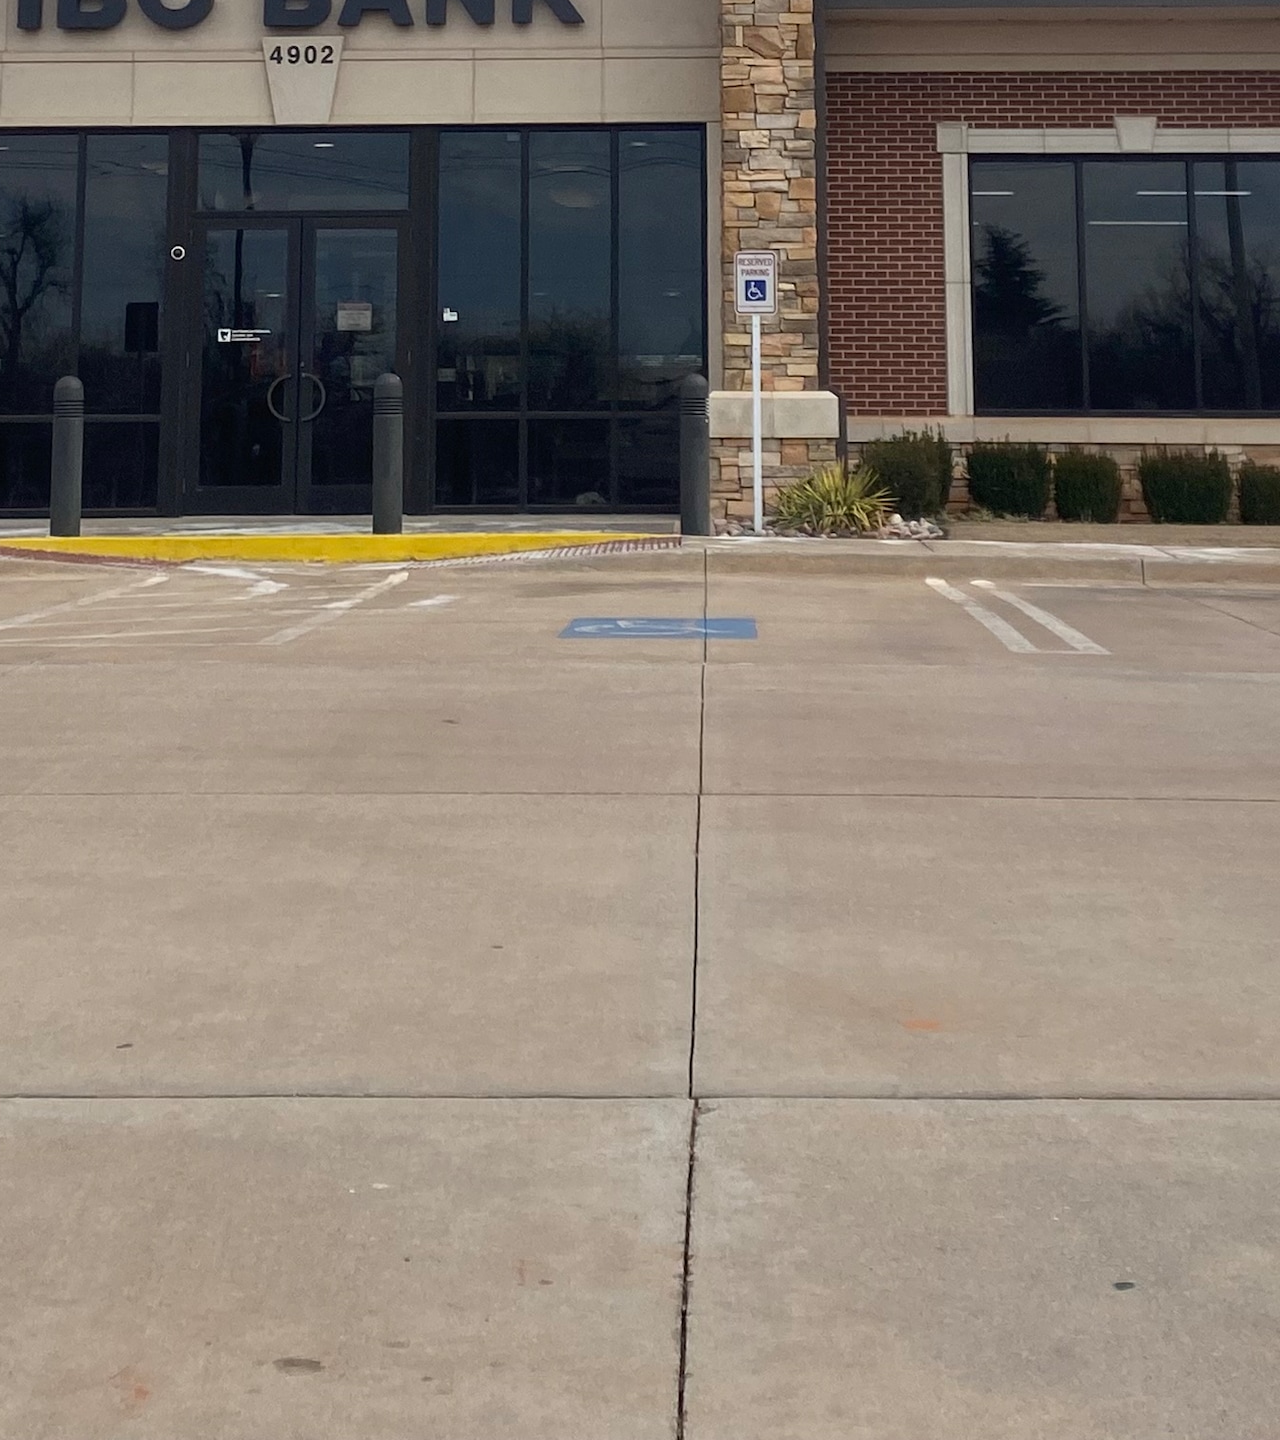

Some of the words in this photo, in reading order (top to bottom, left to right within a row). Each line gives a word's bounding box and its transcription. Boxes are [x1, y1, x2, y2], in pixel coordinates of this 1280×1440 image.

[269, 45, 334, 65] 4902
[738, 257, 773, 267] RESERVED
[741, 268, 770, 276] PARKING
